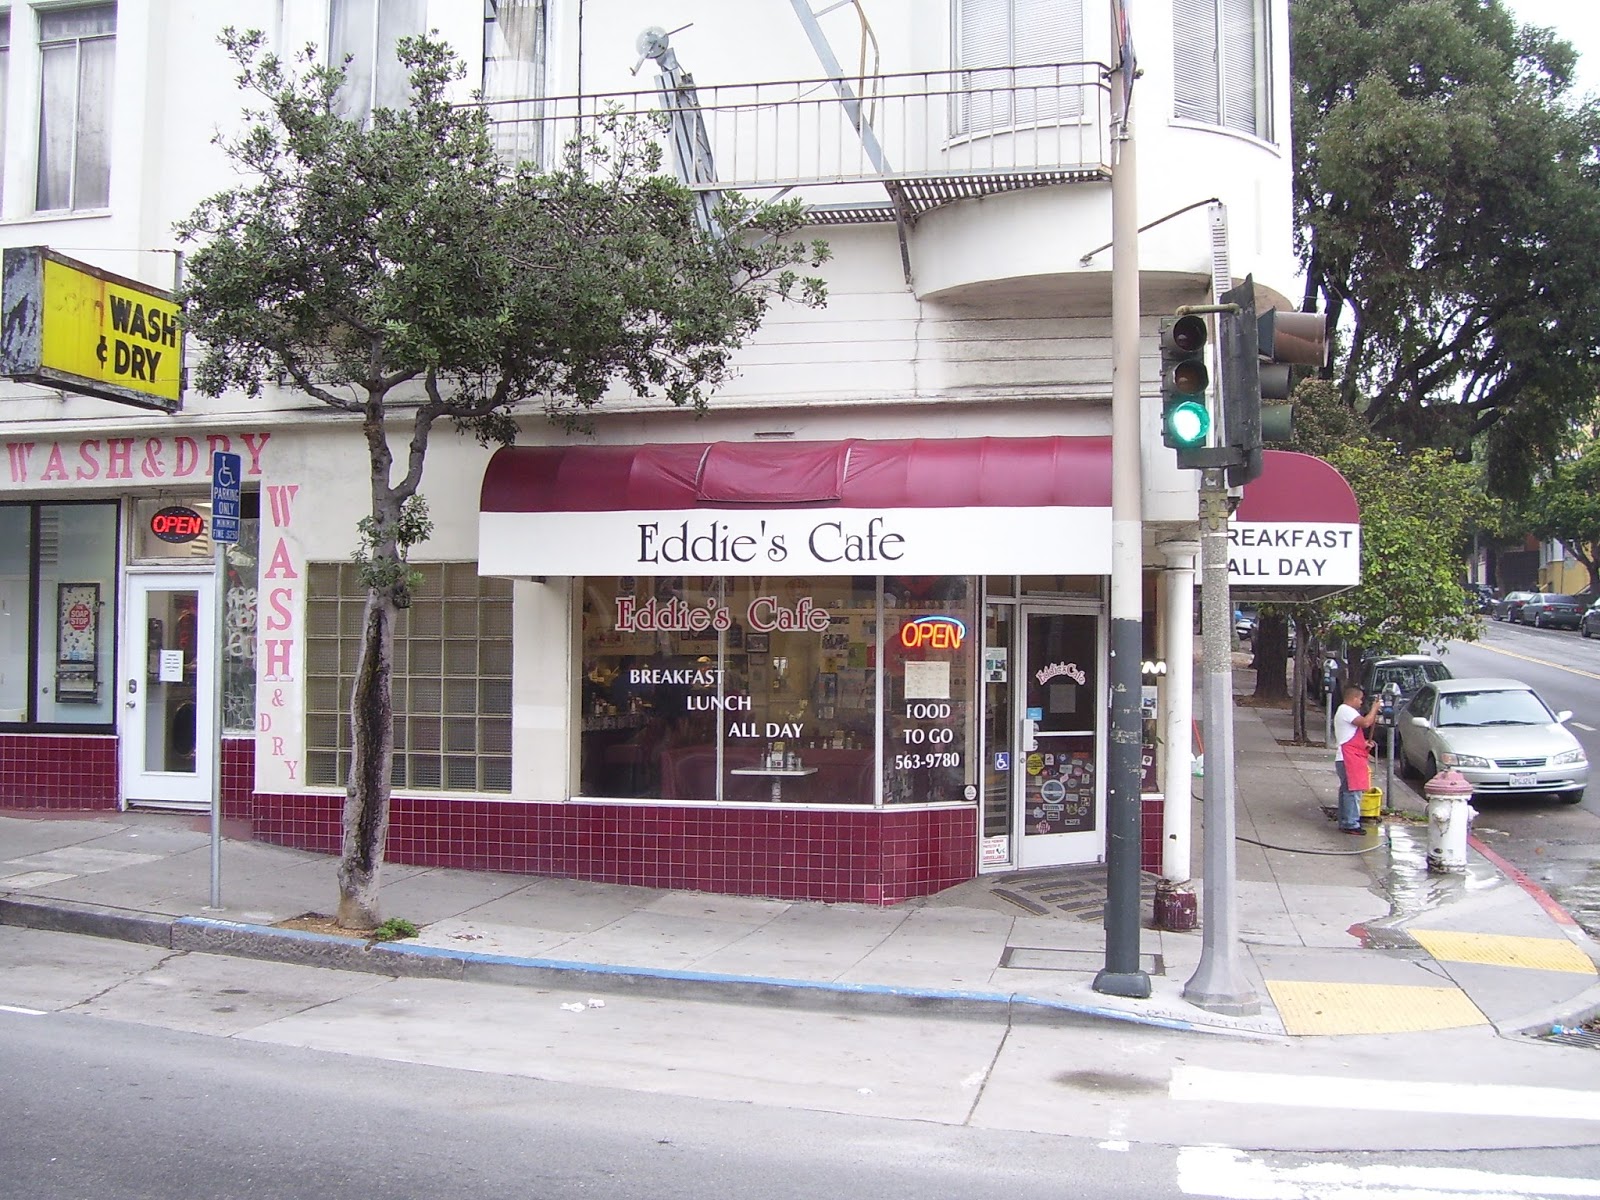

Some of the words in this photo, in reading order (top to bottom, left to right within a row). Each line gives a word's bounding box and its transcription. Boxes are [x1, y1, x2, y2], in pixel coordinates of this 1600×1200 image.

[110, 294, 177, 348] WASH
[114, 340, 162, 384] DRY
[213, 486, 239, 502] PARKING
[218, 501, 235, 516] ONLY
[153, 515, 201, 534] OPEN
[637, 519, 788, 564] Eddie's
[808, 517, 906, 563] Cafe
[1228, 528, 1353, 549] REAKFAST
[1228, 558, 1270, 576] ALL
[1278, 558, 1327, 576] DAY
[264, 485, 299, 682] WASH
[70, 610, 89, 618] SOAP
[615, 595, 731, 633] Eddie's
[747, 596, 831, 633] Cafe
[901, 622, 962, 649] OPEN
[629, 669, 725, 685] BREAKFAST
[686, 695, 751, 711] LUNCH
[906, 703, 951, 719] FOOD
[728, 722, 760, 738] ALL
[766, 723, 804, 738] DAY
[903, 728, 925, 744] TO
[928, 728, 954, 744] GO
[895, 752, 960, 770] 563-9780
